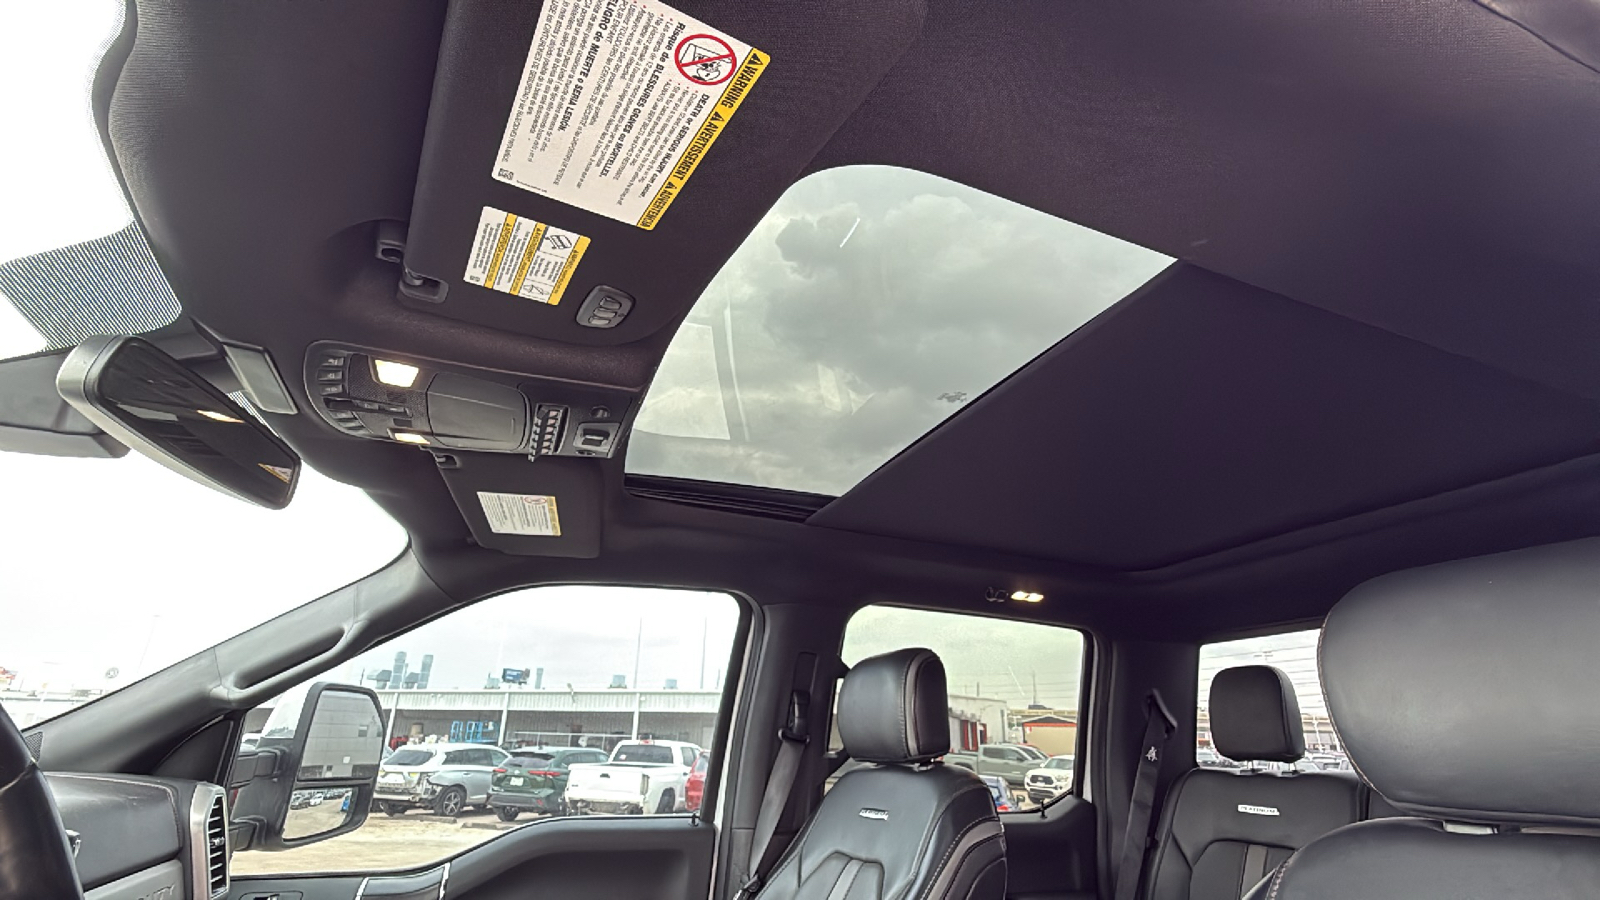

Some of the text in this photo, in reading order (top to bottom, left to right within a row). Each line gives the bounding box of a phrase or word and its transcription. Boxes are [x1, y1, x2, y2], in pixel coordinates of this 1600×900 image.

[592, 30, 604, 44] de
[664, 21, 686, 52] Risque
[578, 42, 599, 78] MUERTE
[658, 50, 670, 63] de
[567, 83, 583, 107] SERIA
[635, 62, 664, 108] BLESSURES
[689, 92, 710, 118] DEATH
[557, 105, 574, 133] LESIÓN.
[621, 106, 641, 133] GRAVES
[684, 117, 694, 125] or
[617, 132, 627, 142] ou
[639, 63, 757, 228] WARNING AVERTISSEMENT ADVERTENCIA
[667, 124, 690, 152] SERIOUS
[598, 141, 623, 178] MORTELLES.
